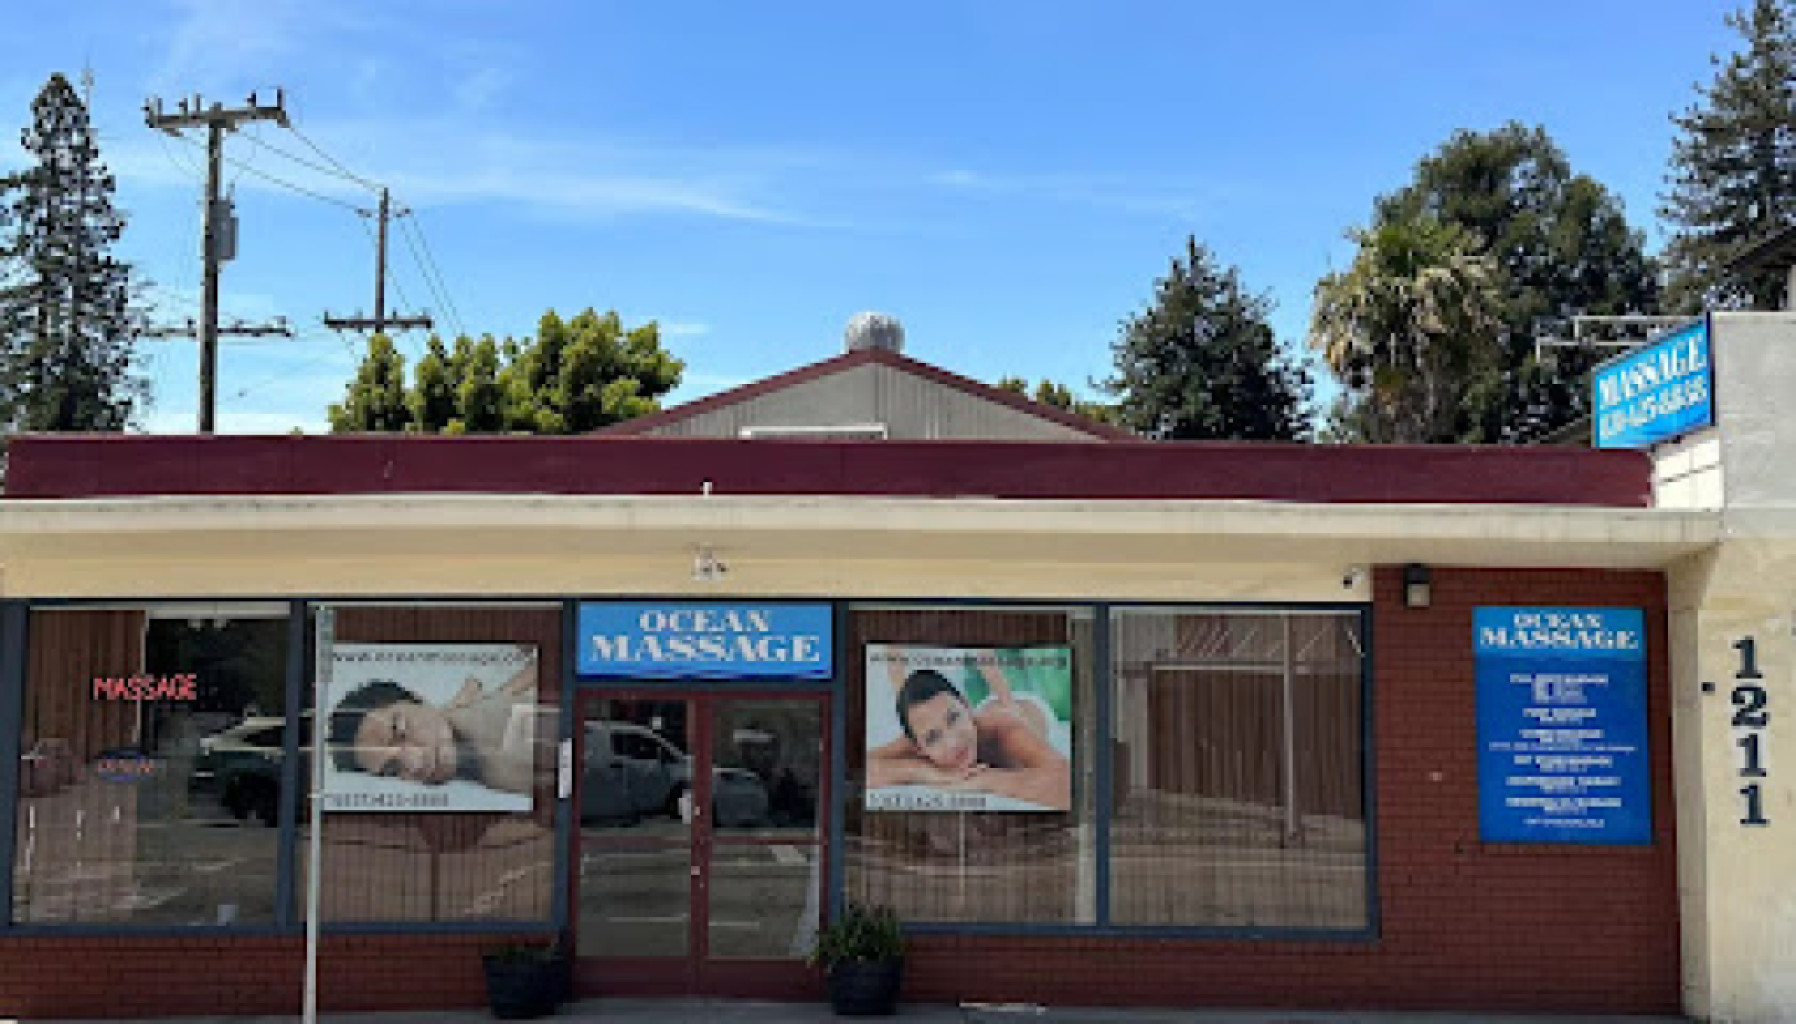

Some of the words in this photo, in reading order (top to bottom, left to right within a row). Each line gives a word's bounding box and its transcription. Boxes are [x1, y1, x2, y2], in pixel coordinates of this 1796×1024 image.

[1599, 333, 1707, 410] MASSAGE
[639, 609, 770, 632] OCEAN
[1513, 613, 1603, 628] OCEAN
[591, 635, 820, 661] MASSAGE
[1479, 626, 1640, 649] MASSAGE
[92, 673, 198, 700] MASSAGE
[1731, 635, 1771, 828] 1211
